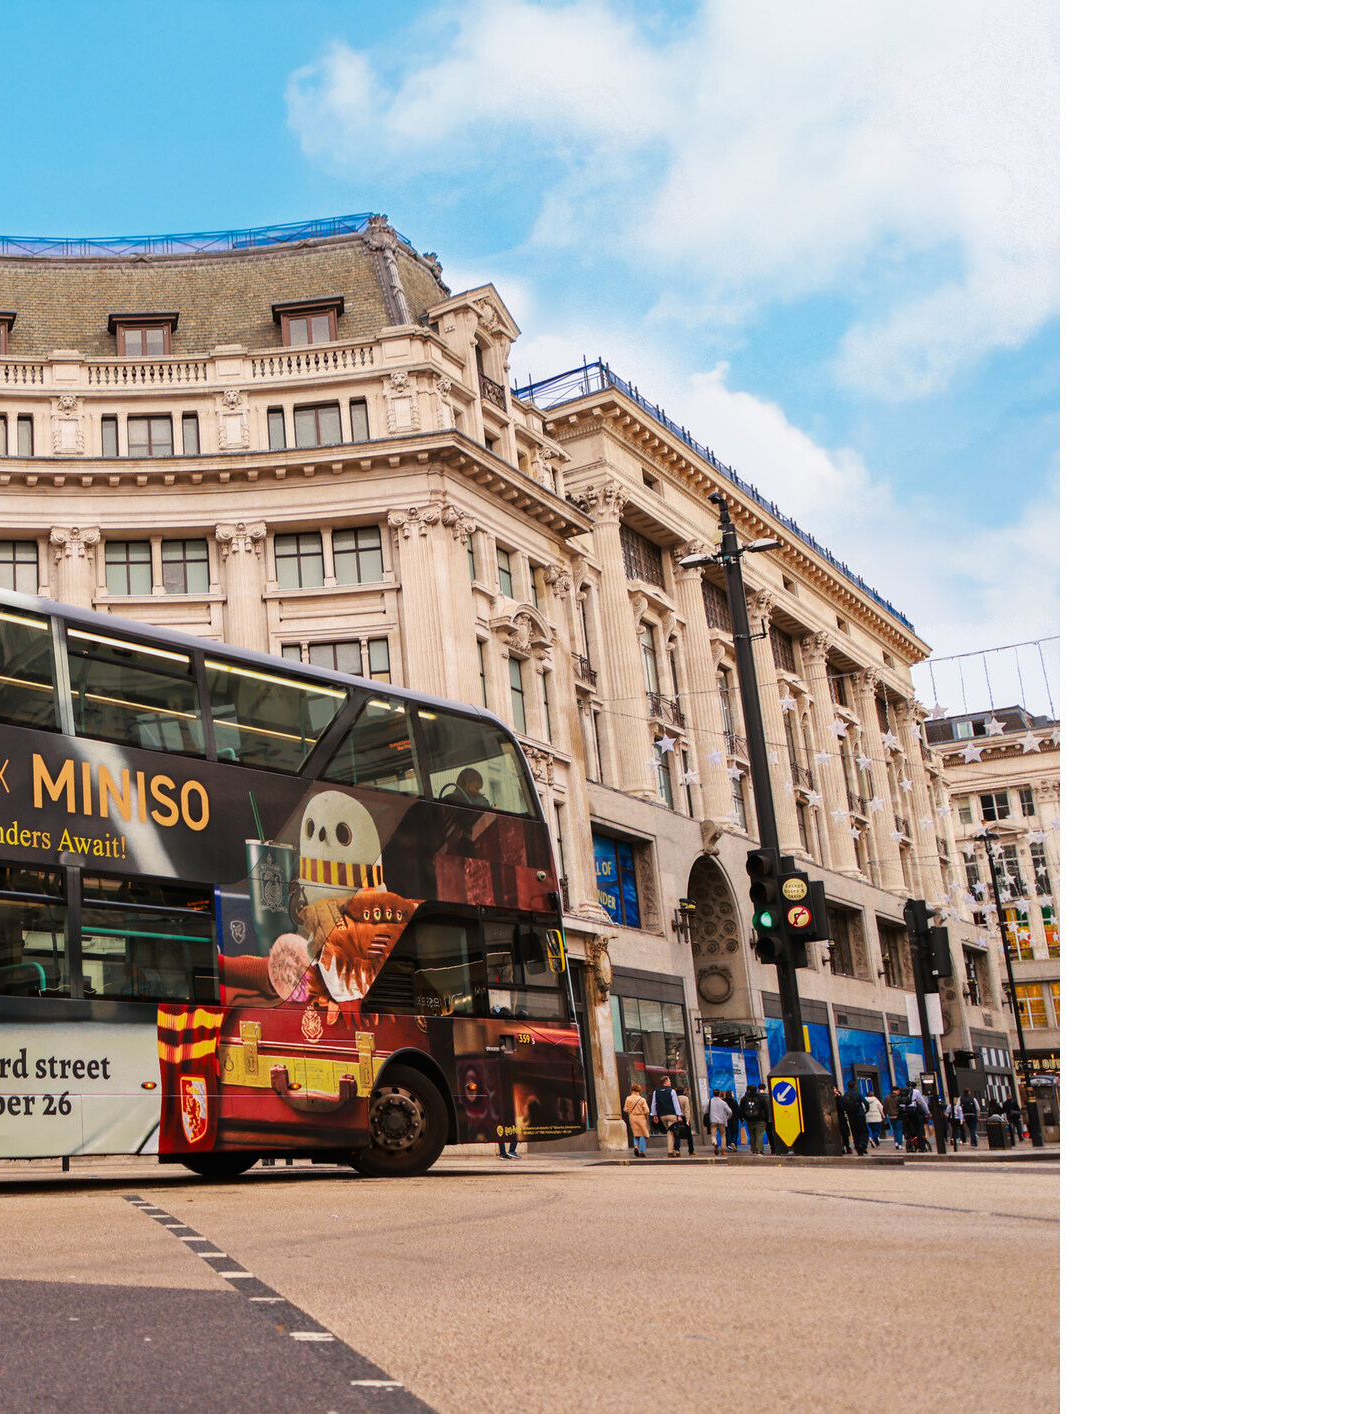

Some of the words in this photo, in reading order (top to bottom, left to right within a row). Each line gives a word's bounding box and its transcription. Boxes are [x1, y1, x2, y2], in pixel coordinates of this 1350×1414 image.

[33, 753, 210, 831] MINISO
[57, 828, 126, 859] Await!
[602, 861, 611, 875] OF
[518, 1034, 530, 1043] 359
[35, 1056, 111, 1080] street
[42, 1091, 72, 1116] 26
